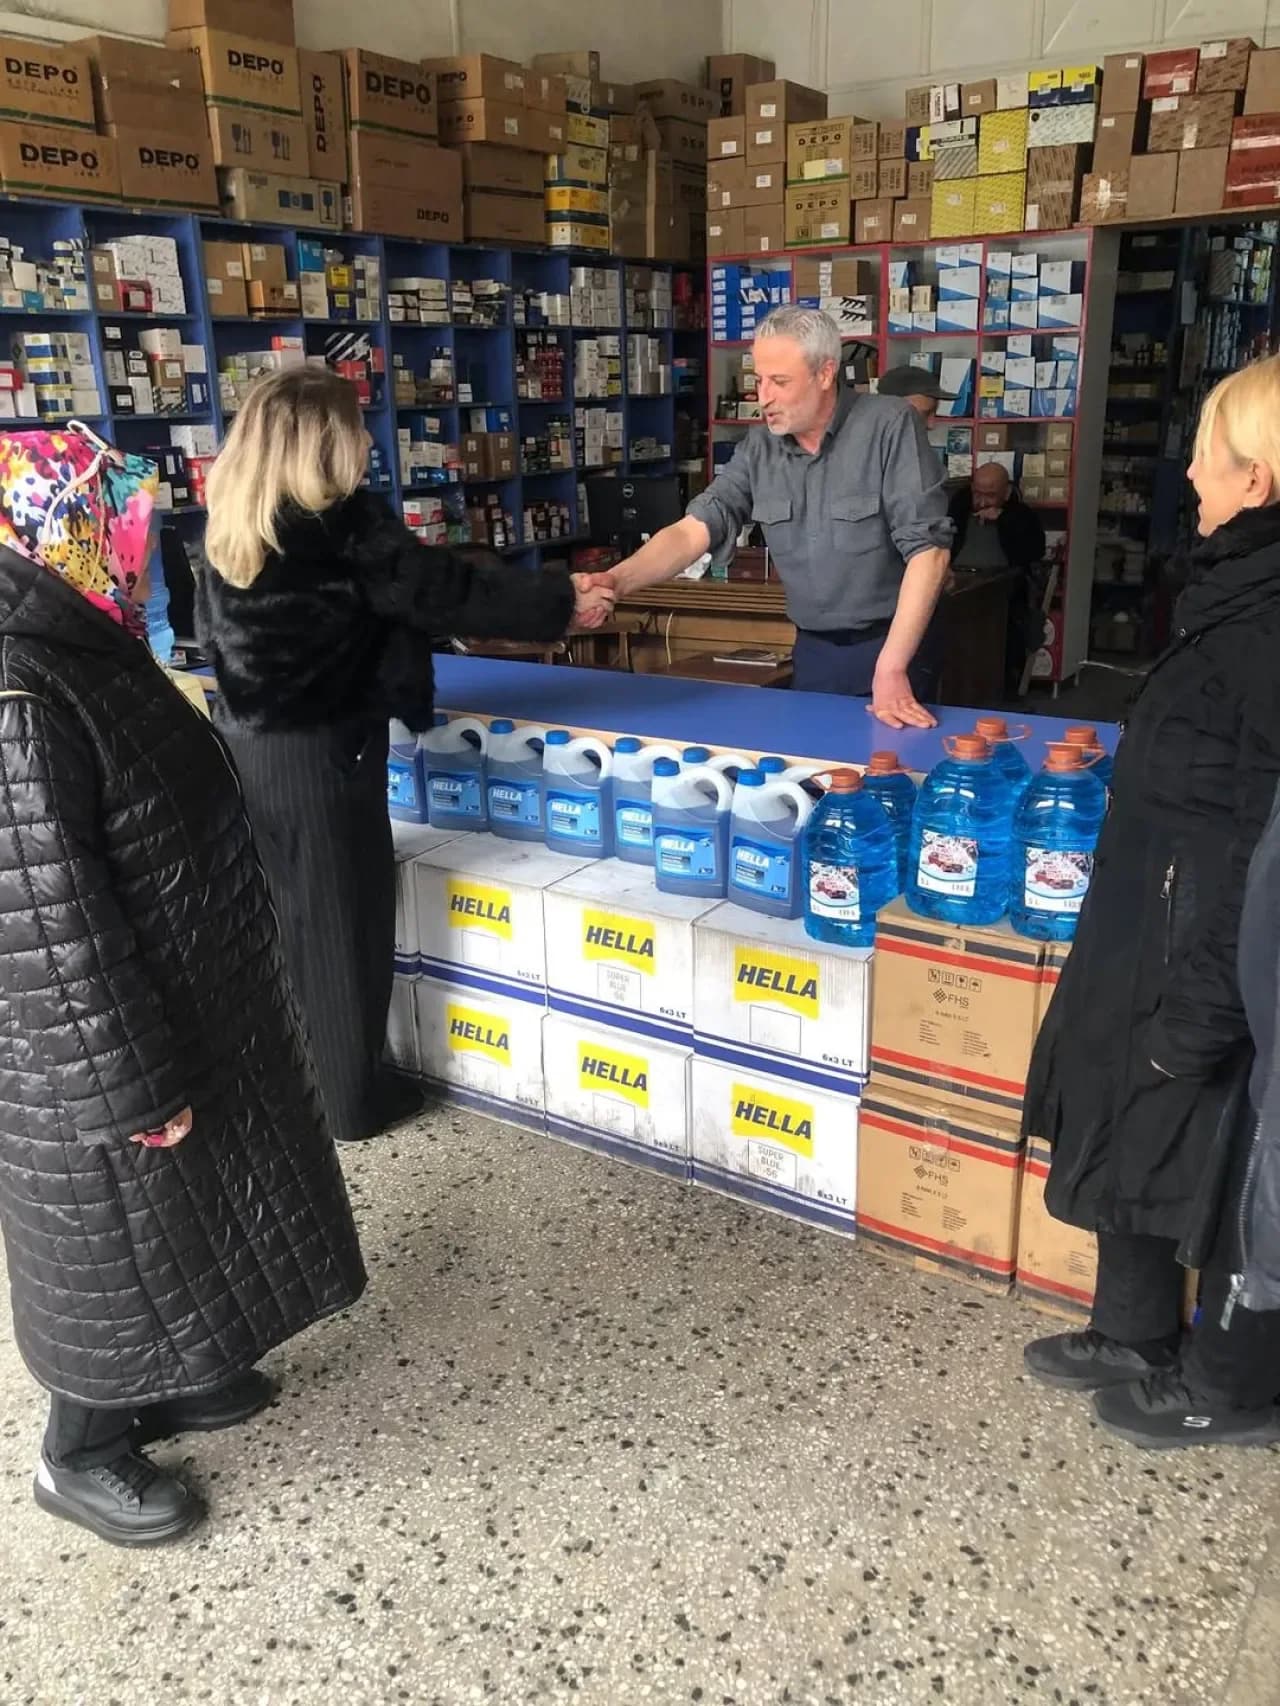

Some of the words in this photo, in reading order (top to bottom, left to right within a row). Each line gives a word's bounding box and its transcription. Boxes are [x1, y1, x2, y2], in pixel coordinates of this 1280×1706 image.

[5, 57, 78, 84] DEPO
[227, 50, 284, 75] DEPO
[365, 70, 431, 105] DEPO
[312, 74, 326, 152] DEPO
[798, 133, 841, 146] DEPO
[20, 143, 98, 169] DEPO
[138, 147, 199, 170] DEPO
[416, 207, 449, 223] DEPO
[795, 199, 838, 210] DEPO
[433, 780, 462, 793] HELLA
[492, 788, 522, 801] HELLA
[551, 800, 582, 816] HELLA
[450, 894, 511, 924] HELLA
[585, 925, 654, 958] HELLA
[737, 963, 817, 1000] HELLA
[947, 993, 969, 1007] FHS
[450, 1018, 509, 1050] HELLA
[581, 1056, 647, 1091] HELLA
[842, 1058, 854, 1068] LT
[735, 1100, 811, 1140] HELLA
